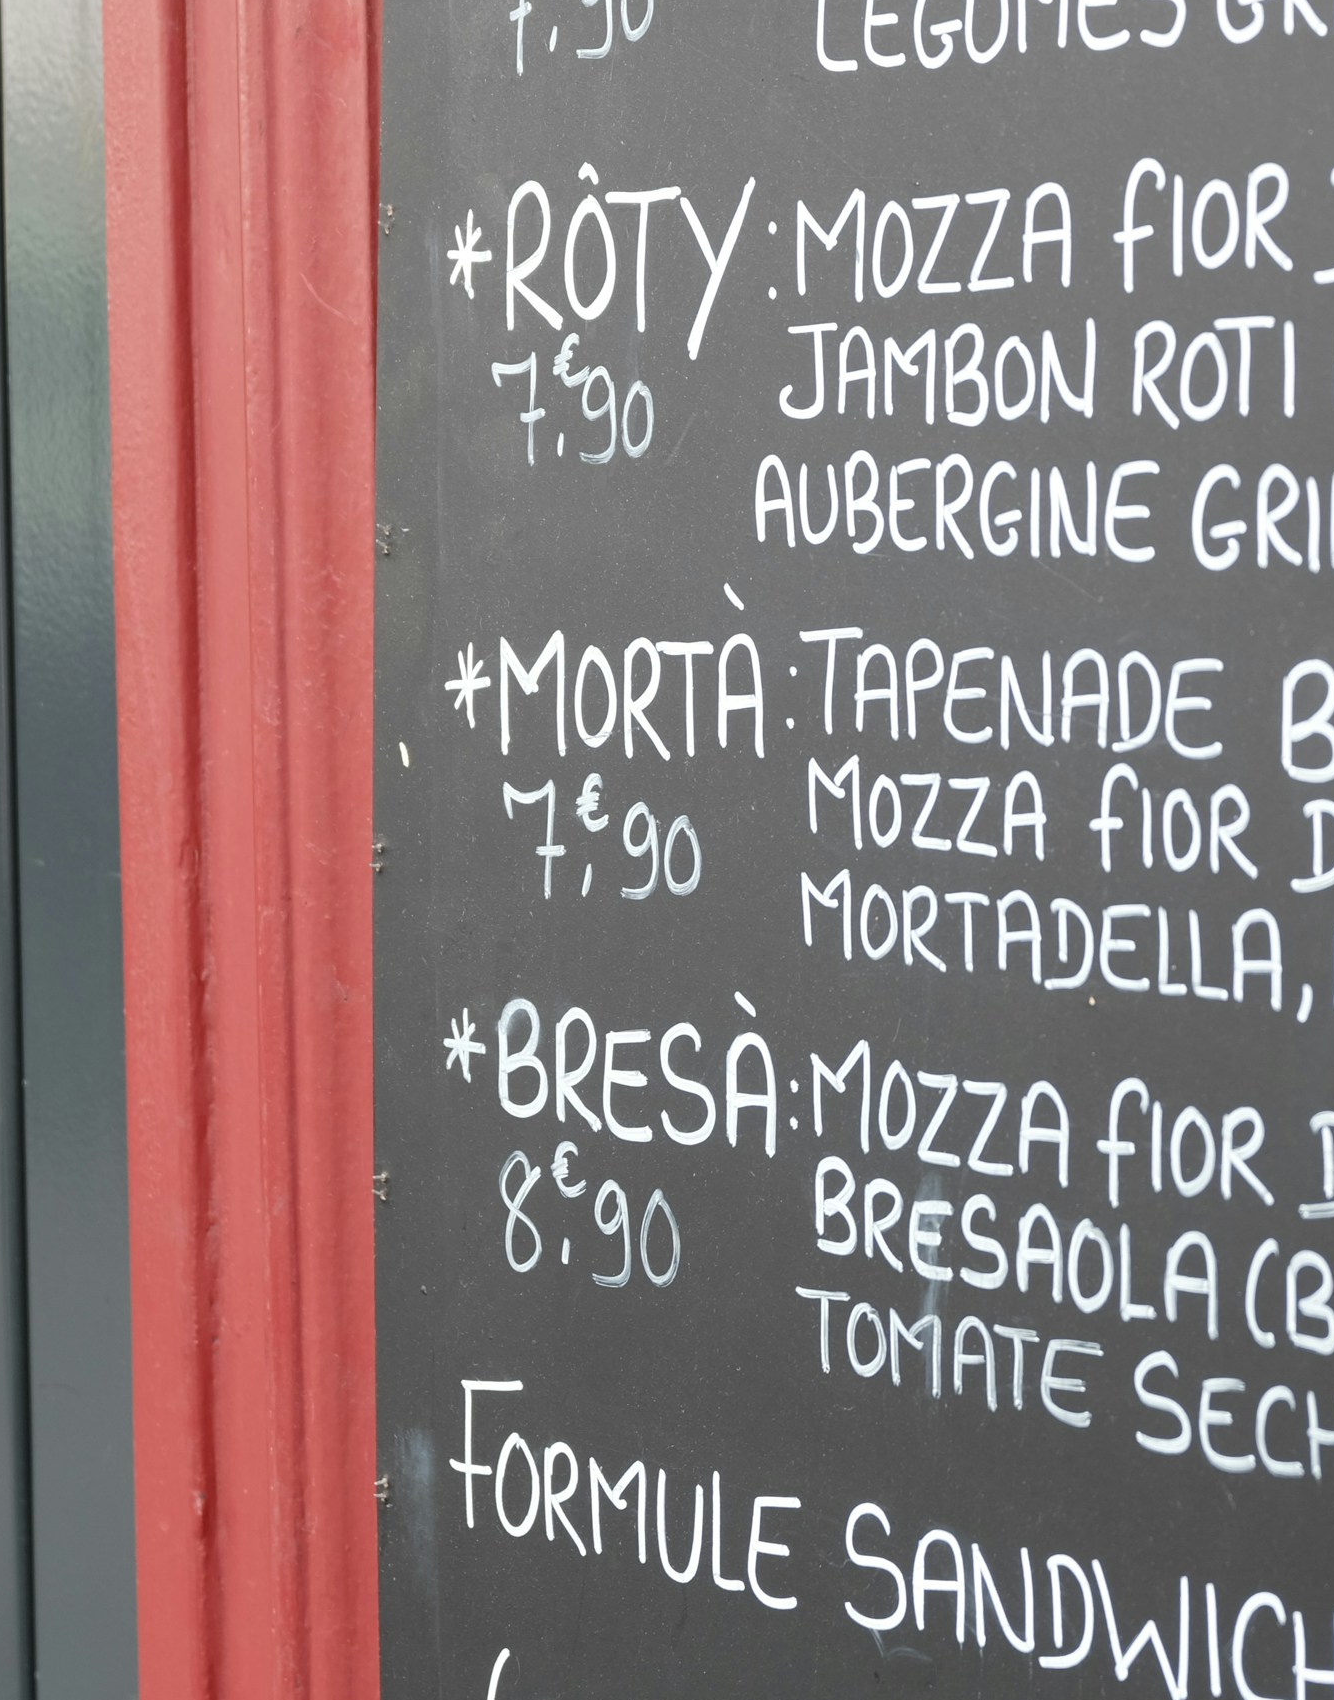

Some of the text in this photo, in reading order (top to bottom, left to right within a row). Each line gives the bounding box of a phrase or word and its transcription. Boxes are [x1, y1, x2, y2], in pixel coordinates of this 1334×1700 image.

[797, 182, 1071, 302] MOZZA
[779, 318, 1096, 427] JAMBON
[1133, 316, 1295, 430] ROTI
[755, 450, 1160, 562] AUBERGINE
[799, 627, 1223, 759] TAPENADE
[808, 755, 1047, 861] MOZZA
[810, 1040, 1069, 1188] MOZZA
[815, 1156, 1218, 1339] BRESAOLA
[795, 1286, 1104, 1427] TOMATE
[449, 1379, 801, 1610] FORMULE
